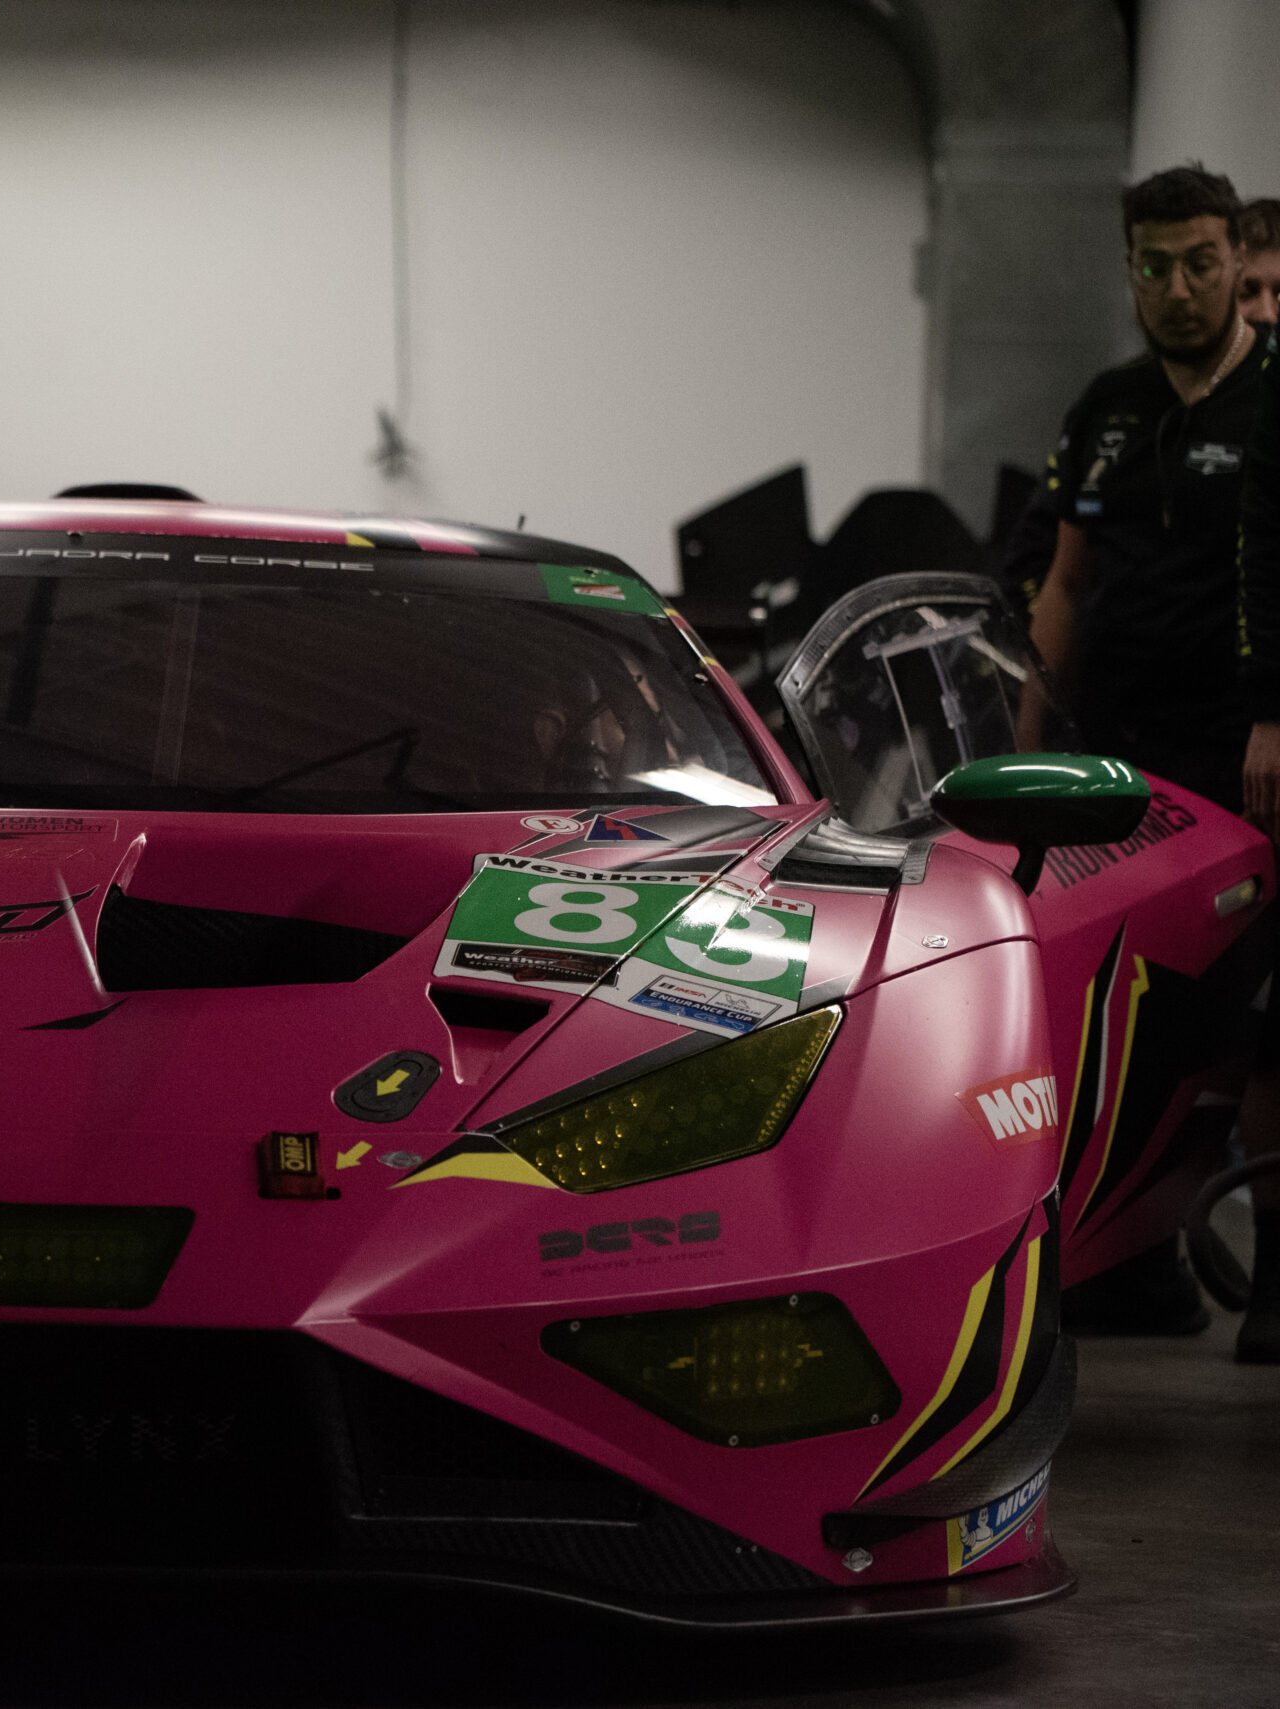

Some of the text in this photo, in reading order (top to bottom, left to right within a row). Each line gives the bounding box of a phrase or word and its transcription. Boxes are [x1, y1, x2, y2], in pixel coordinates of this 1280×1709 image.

[194, 554, 375, 572] CORSE
[650, 990, 754, 1023] ENDURANCE CUP
[976, 1075, 1059, 1141] MOTU
[26, 1412, 240, 1462] LYNX
